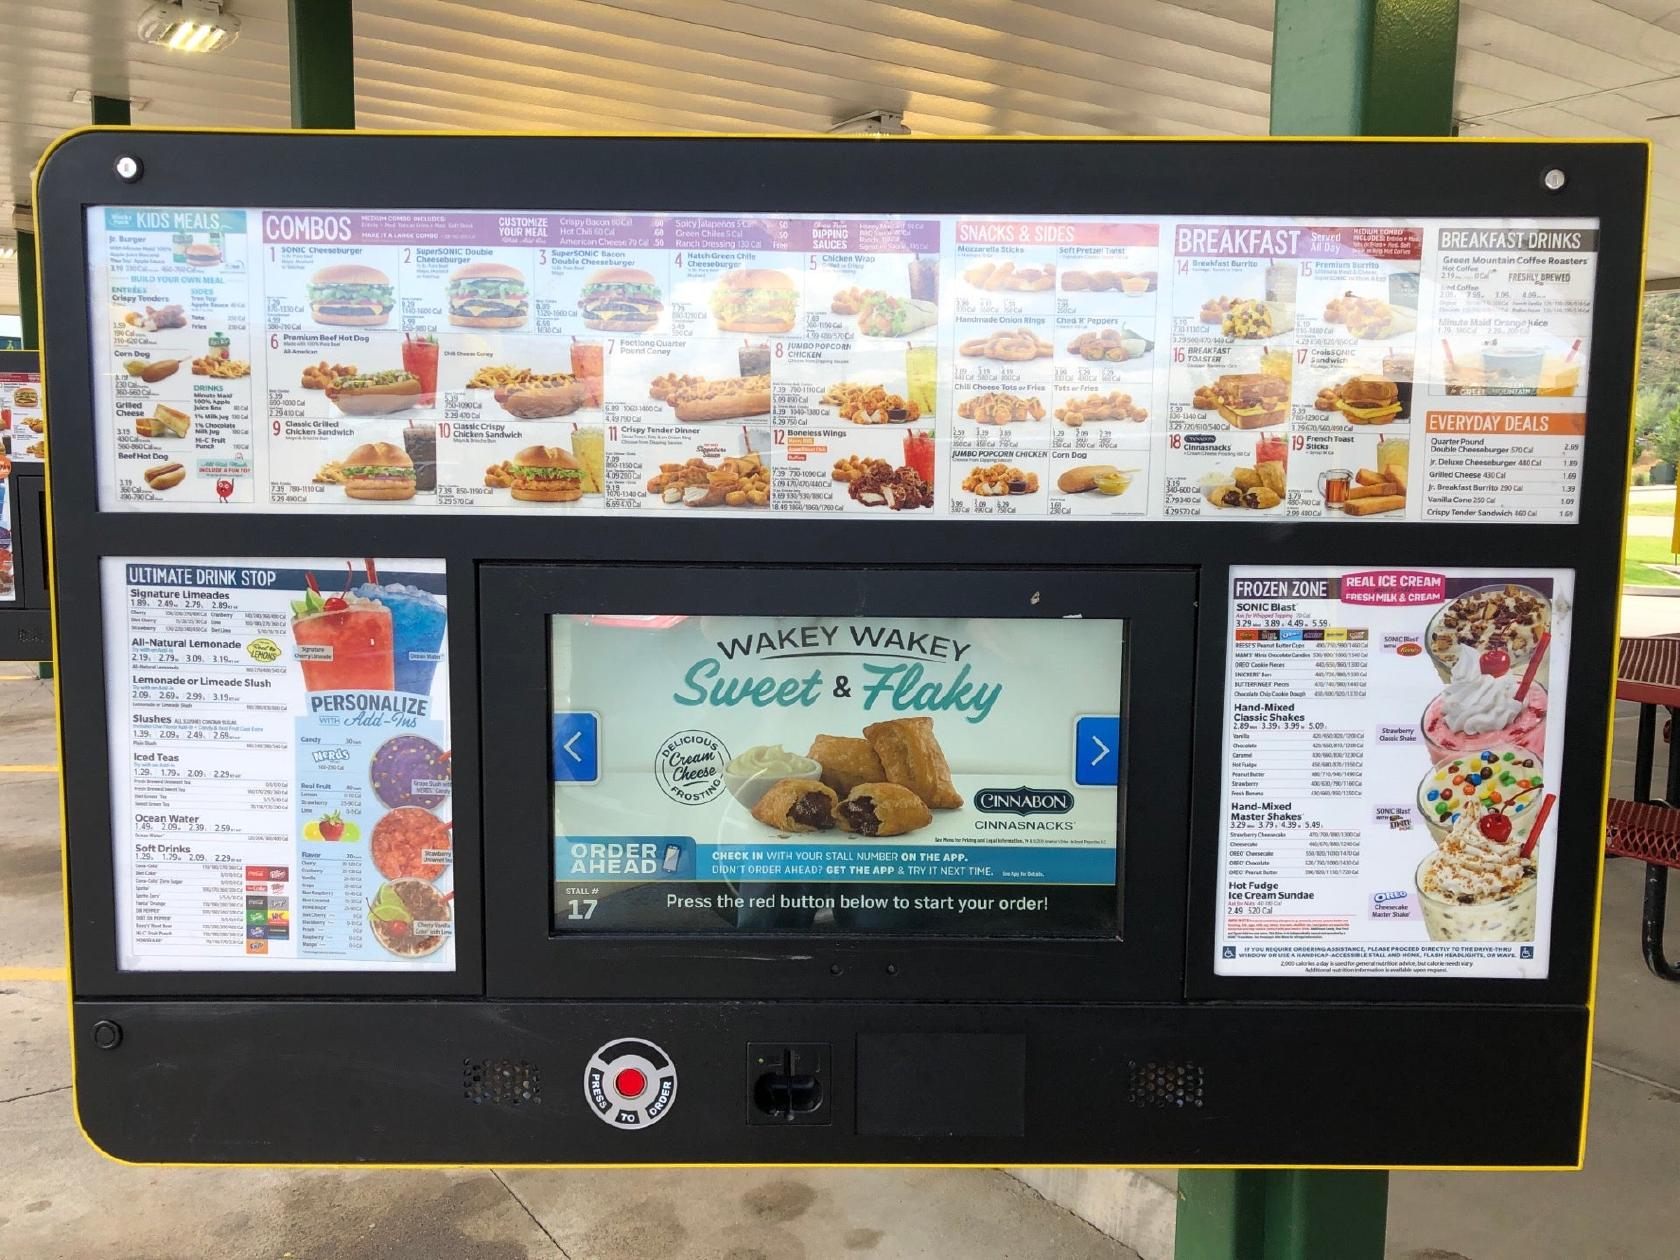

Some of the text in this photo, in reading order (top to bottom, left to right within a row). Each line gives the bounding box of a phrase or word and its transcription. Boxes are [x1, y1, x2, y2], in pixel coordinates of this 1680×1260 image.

[136, 213, 220, 230] KIDS MEALS
[499, 217, 548, 228] CUSTOMIZE
[266, 215, 352, 241] COMBOS
[499, 227, 548, 237] YOUR MEAL
[960, 224, 1075, 242] SNACKS & SIDES
[812, 230, 848, 239] DIPPING
[1311, 232, 1341, 242] Served
[812, 240, 847, 250] SAUCES
[1178, 228, 1300, 254] BREAKFAST
[1442, 232, 1581, 249] BREAKFAST DRINKS
[1311, 243, 1340, 254] All Day
[273, 421, 281, 436] 9
[285, 420, 339, 428] Classic Grilled
[453, 422, 505, 432] Classic Crispy
[1430, 415, 1549, 431] EVERYDAY DEALS
[318, 428, 354, 436] Sandwich
[438, 423, 450, 438] 10
[453, 430, 522, 438] Chicken Sandwich
[788, 429, 847, 438] Boneless Wings
[774, 430, 785, 445] 12
[1169, 435, 1181, 448] 18
[1292, 436, 1303, 450] 19
[1072, 452, 1087, 460] Dog
[1465, 459, 1516, 467] Cheeseburger
[1427, 509, 1450, 517] Crispy
[129, 568, 276, 586] ULTIMATE DRINK STOP
[1347, 576, 1441, 587] REAL ICE CREAM
[131, 589, 230, 600] Signature Limeades
[1236, 581, 1327, 597] FROZEN ZONE
[1346, 593, 1376, 601] FRESH
[1377, 594, 1397, 602] MILK
[1408, 593, 1440, 601] CREAM
[1271, 603, 1296, 611] Blast
[132, 639, 241, 649] All-Natural Lemonade
[716, 626, 971, 661] WAKEY WAKEY
[133, 676, 185, 685] Lemonade
[200, 677, 243, 687] Limeade
[245, 679, 271, 688] Slush
[673, 658, 1003, 724] Sweet & Flaky
[311, 694, 428, 716] PERSONALIZE
[133, 715, 172, 723] Slushes
[1270, 714, 1305, 722] Shakes
[662, 736, 718, 758] DELICIOUS
[134, 753, 179, 762] Iced Teas
[669, 751, 715, 768] Cream
[672, 765, 716, 782] Cheese
[671, 778, 721, 801] FROSTING
[980, 792, 1071, 810] CINNABON
[1232, 803, 1291, 811] Hand-Mixed
[135, 814, 200, 823] Ocean Water
[1231, 813, 1302, 821] Master Shakes
[974, 820, 1073, 831] CINNASNACKS
[136, 844, 190, 853] Soft Drinks
[571, 843, 657, 858] ORDER
[712, 852, 968, 863] CHECK IN WITH YOUR STALL NUMBER ON THE APP.
[571, 859, 657, 873] AHEAD
[712, 865, 993, 876] DIDN'T ORDER AHEAD? GET THE APP & TRY IT NEXT TIME.
[1249, 882, 1278, 891] Fudge
[1374, 891, 1407, 903] OREO
[667, 894, 1048, 913] Press the red button below to start your order!
[568, 900, 598, 919] 17
[592, 1074, 607, 1109] PRESS
[649, 1082, 671, 1115] ORDER
[621, 1114, 635, 1122] TO
